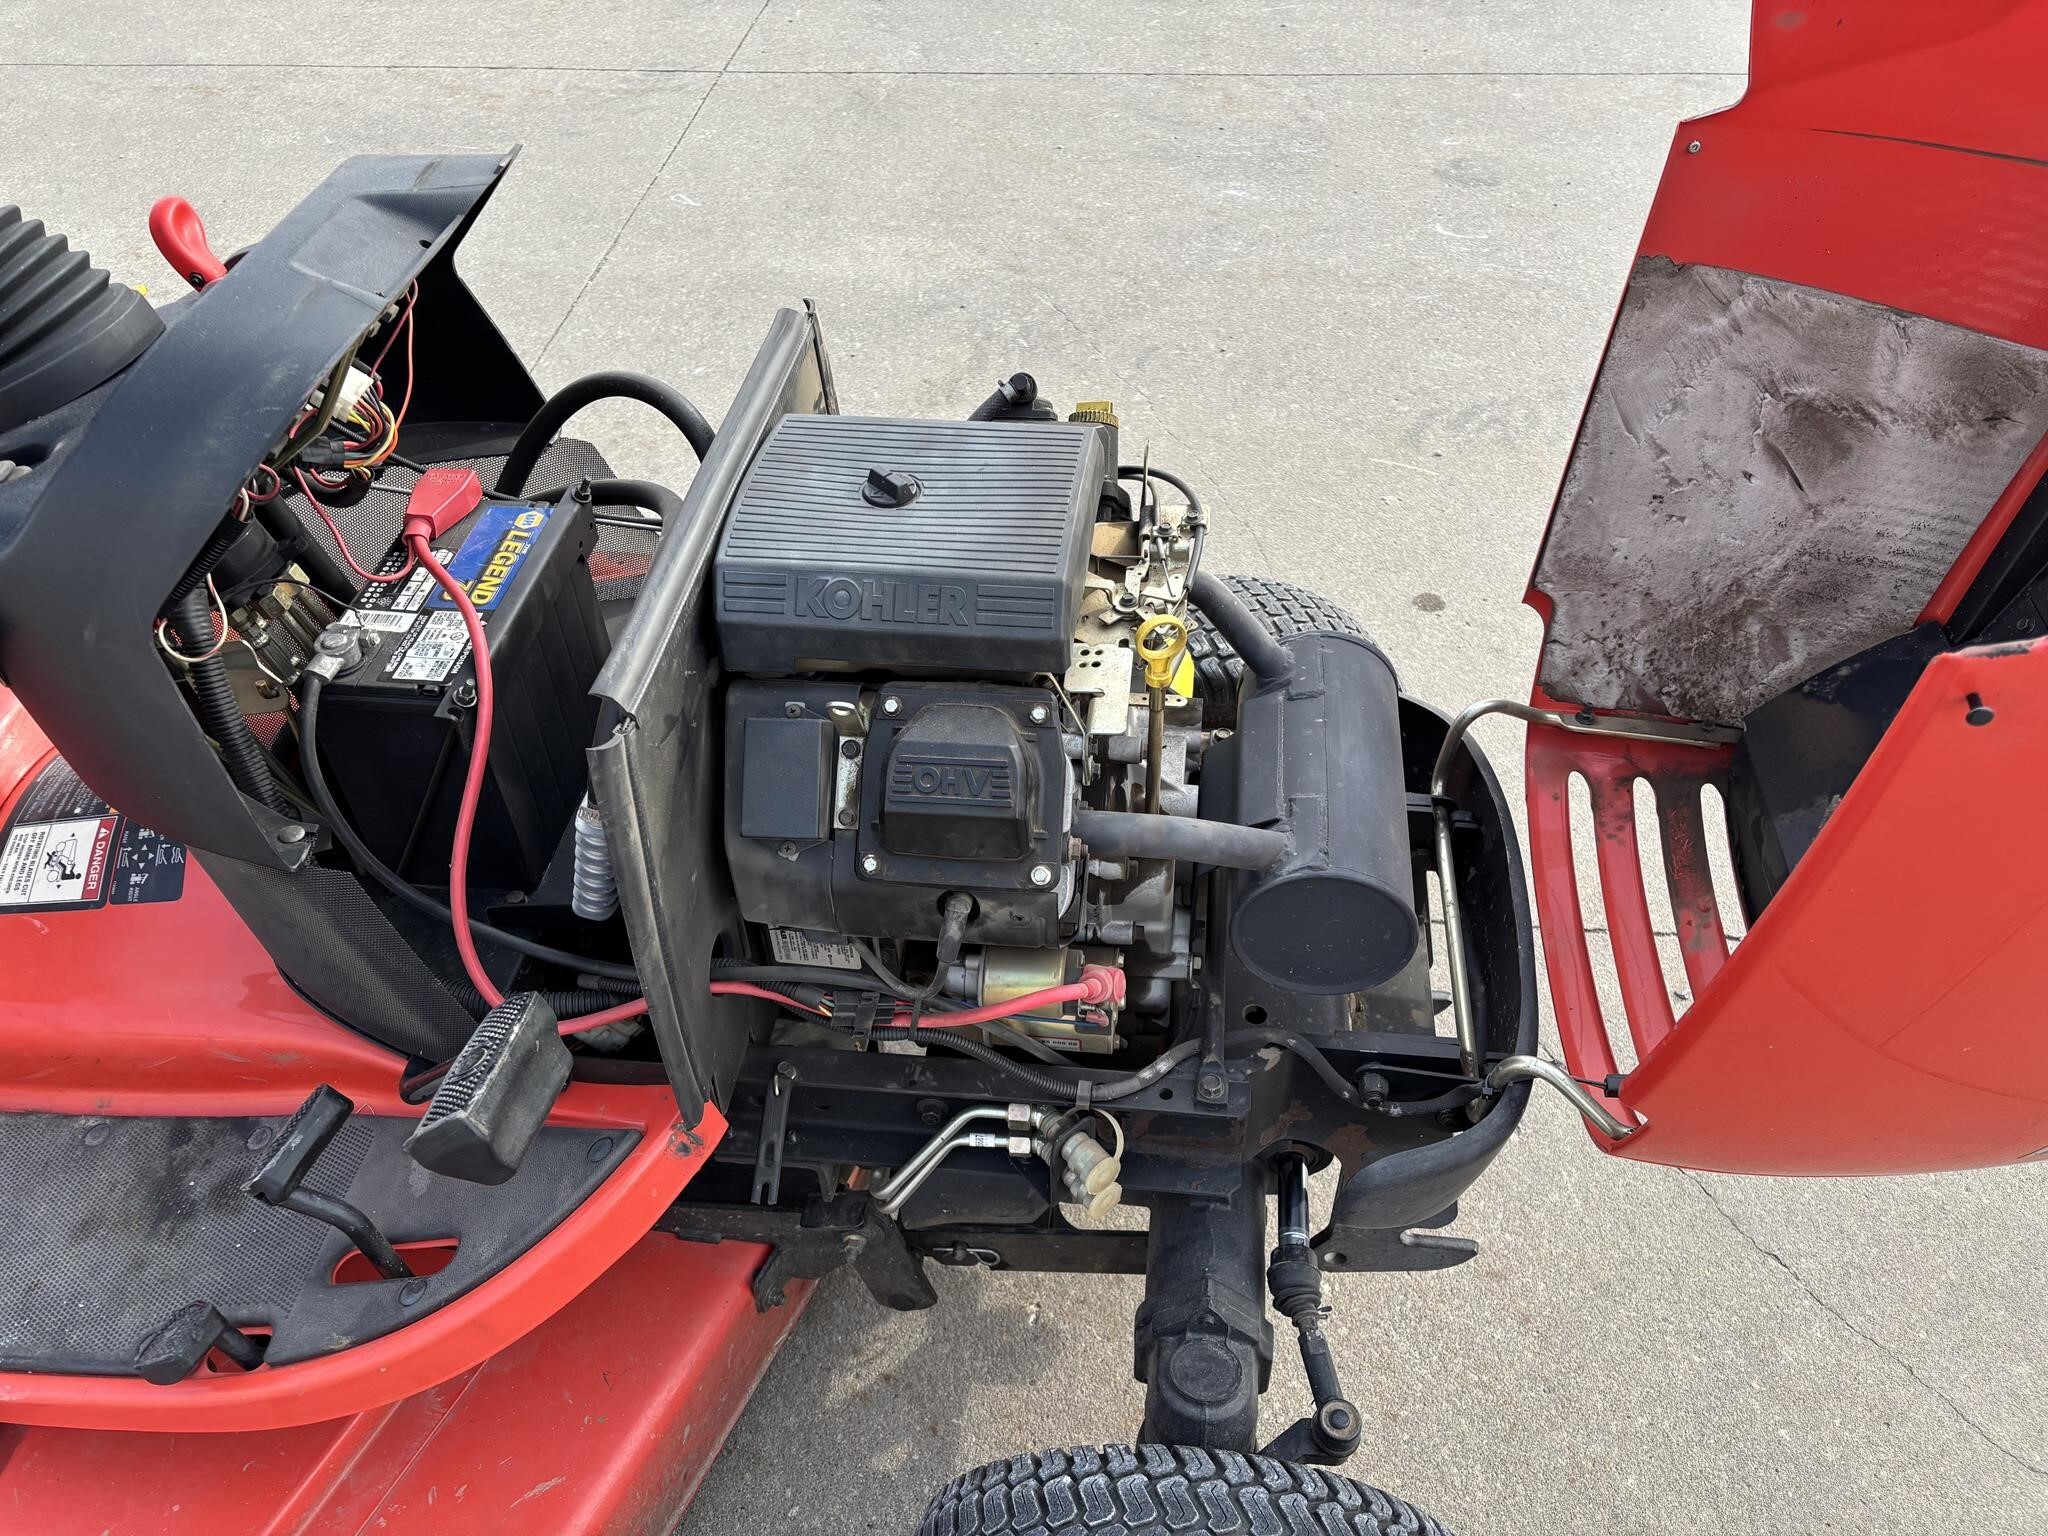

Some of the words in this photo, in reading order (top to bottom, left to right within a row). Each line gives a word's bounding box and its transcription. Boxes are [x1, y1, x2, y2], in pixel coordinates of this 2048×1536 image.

[470, 530, 534, 605] LEGEND
[795, 577, 969, 626] KOHLER
[914, 766, 990, 797] OHV
[30, 832, 38, 843] OFF
[32, 831, 46, 860] ROTATING
[23, 844, 34, 861] ARMS
[18, 862, 27, 875] AND
[24, 860, 36, 883] BLADES
[86, 843, 106, 891] DANGER
[13, 876, 22, 891] LEGS
[20, 884, 29, 896] CUT
